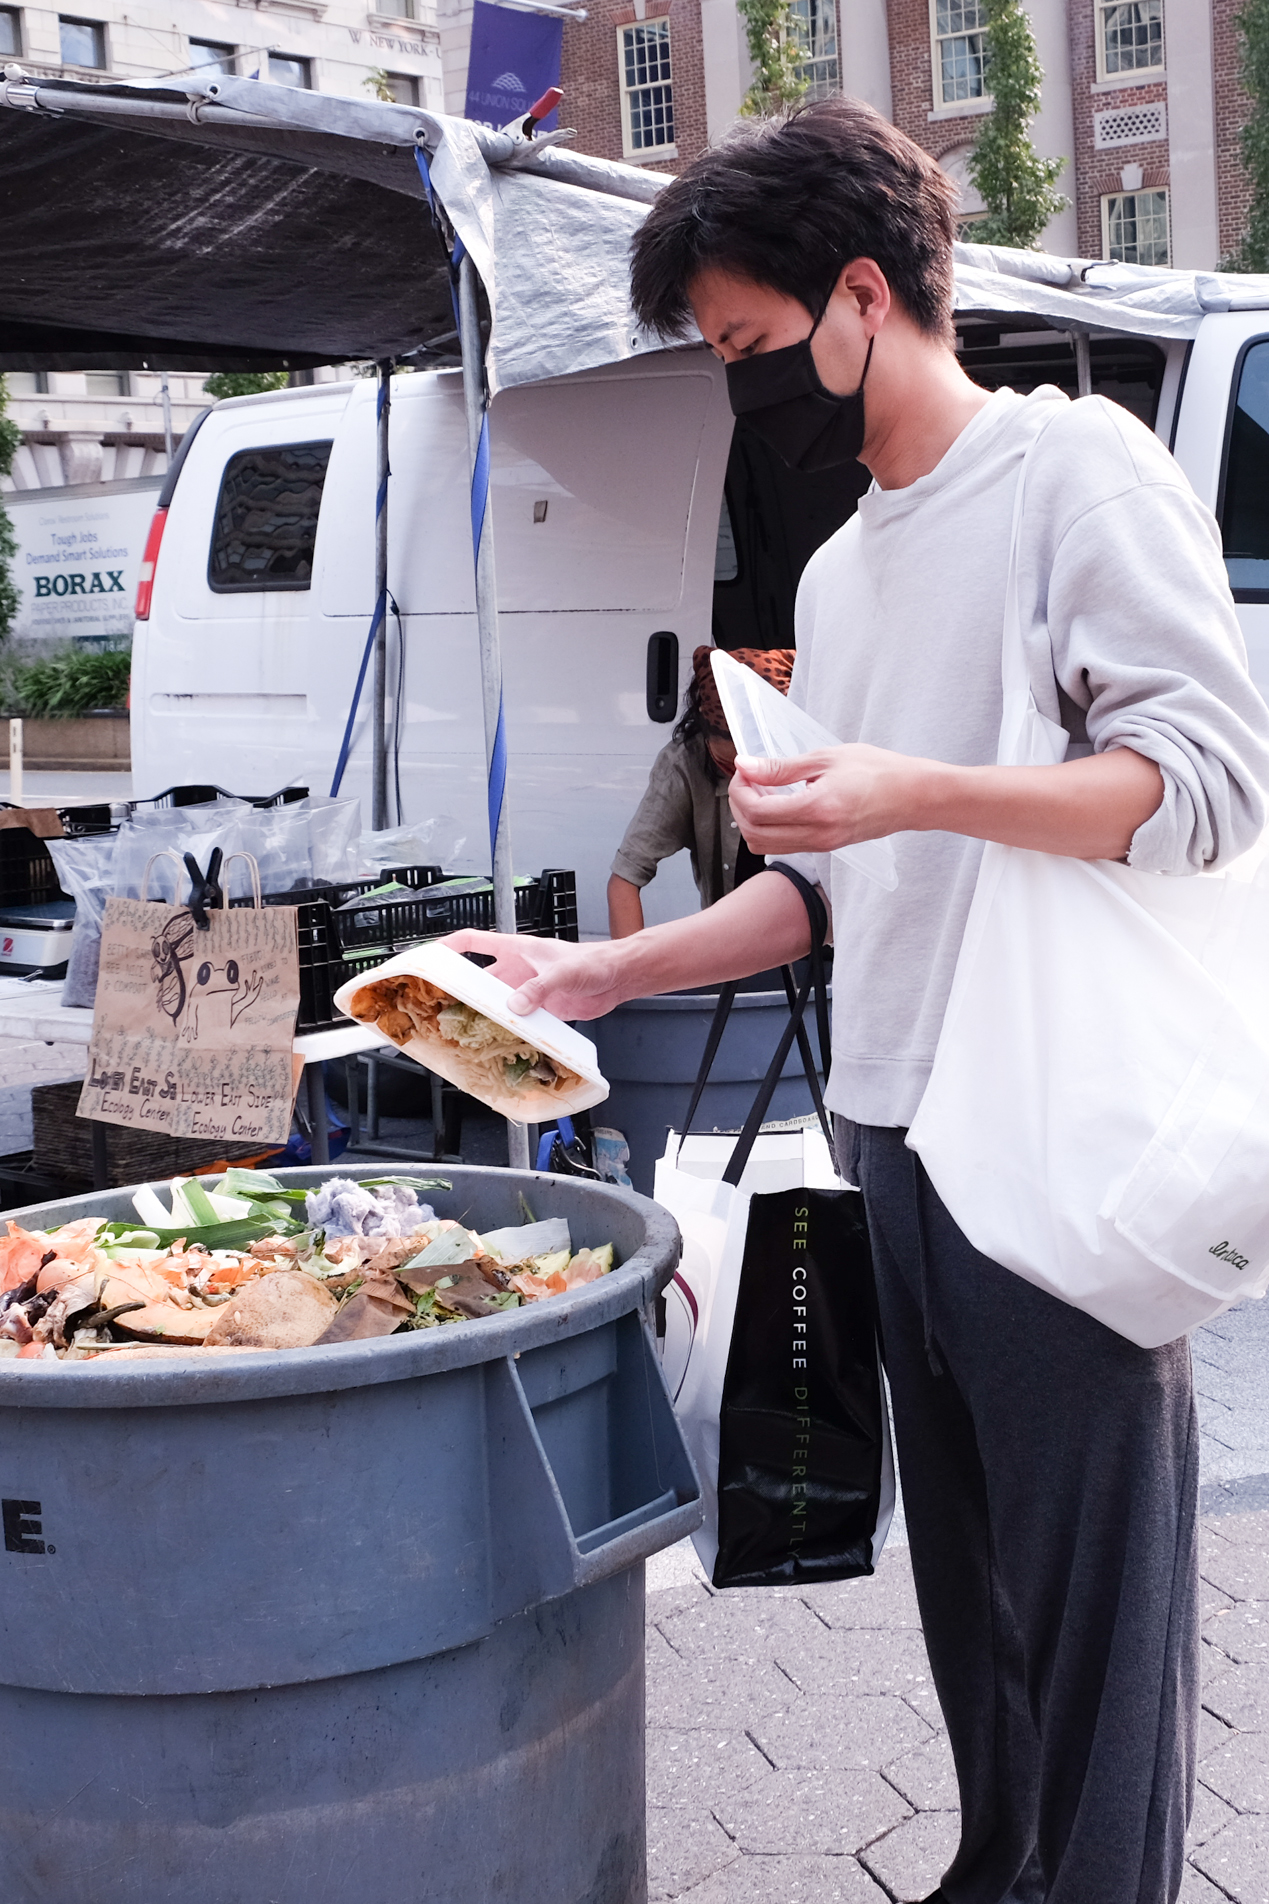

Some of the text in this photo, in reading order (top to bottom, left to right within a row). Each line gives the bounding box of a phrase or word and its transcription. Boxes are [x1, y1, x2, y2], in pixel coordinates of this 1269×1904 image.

[348, 28, 361, 44] W
[369, 34, 395, 50] NEW
[397, 40, 428, 56] YORK
[480, 92, 510, 109] UNION
[51, 530, 98, 547] Tough Jobs
[26, 546, 128, 565] Demand Smart Solutions
[33, 570, 125, 597] BORAX
[128, 1066, 158, 1098] EAST
[180, 1082, 272, 1109] LOWER EAST SIDE
[101, 1091, 172, 1121] Ecology Center
[191, 1111, 263, 1139] Ecology Center
[792, 1206, 809, 1250] SEE
[792, 1267, 807, 1369] COFFEE
[786, 1386, 811, 1559] DIFFERENTLY
